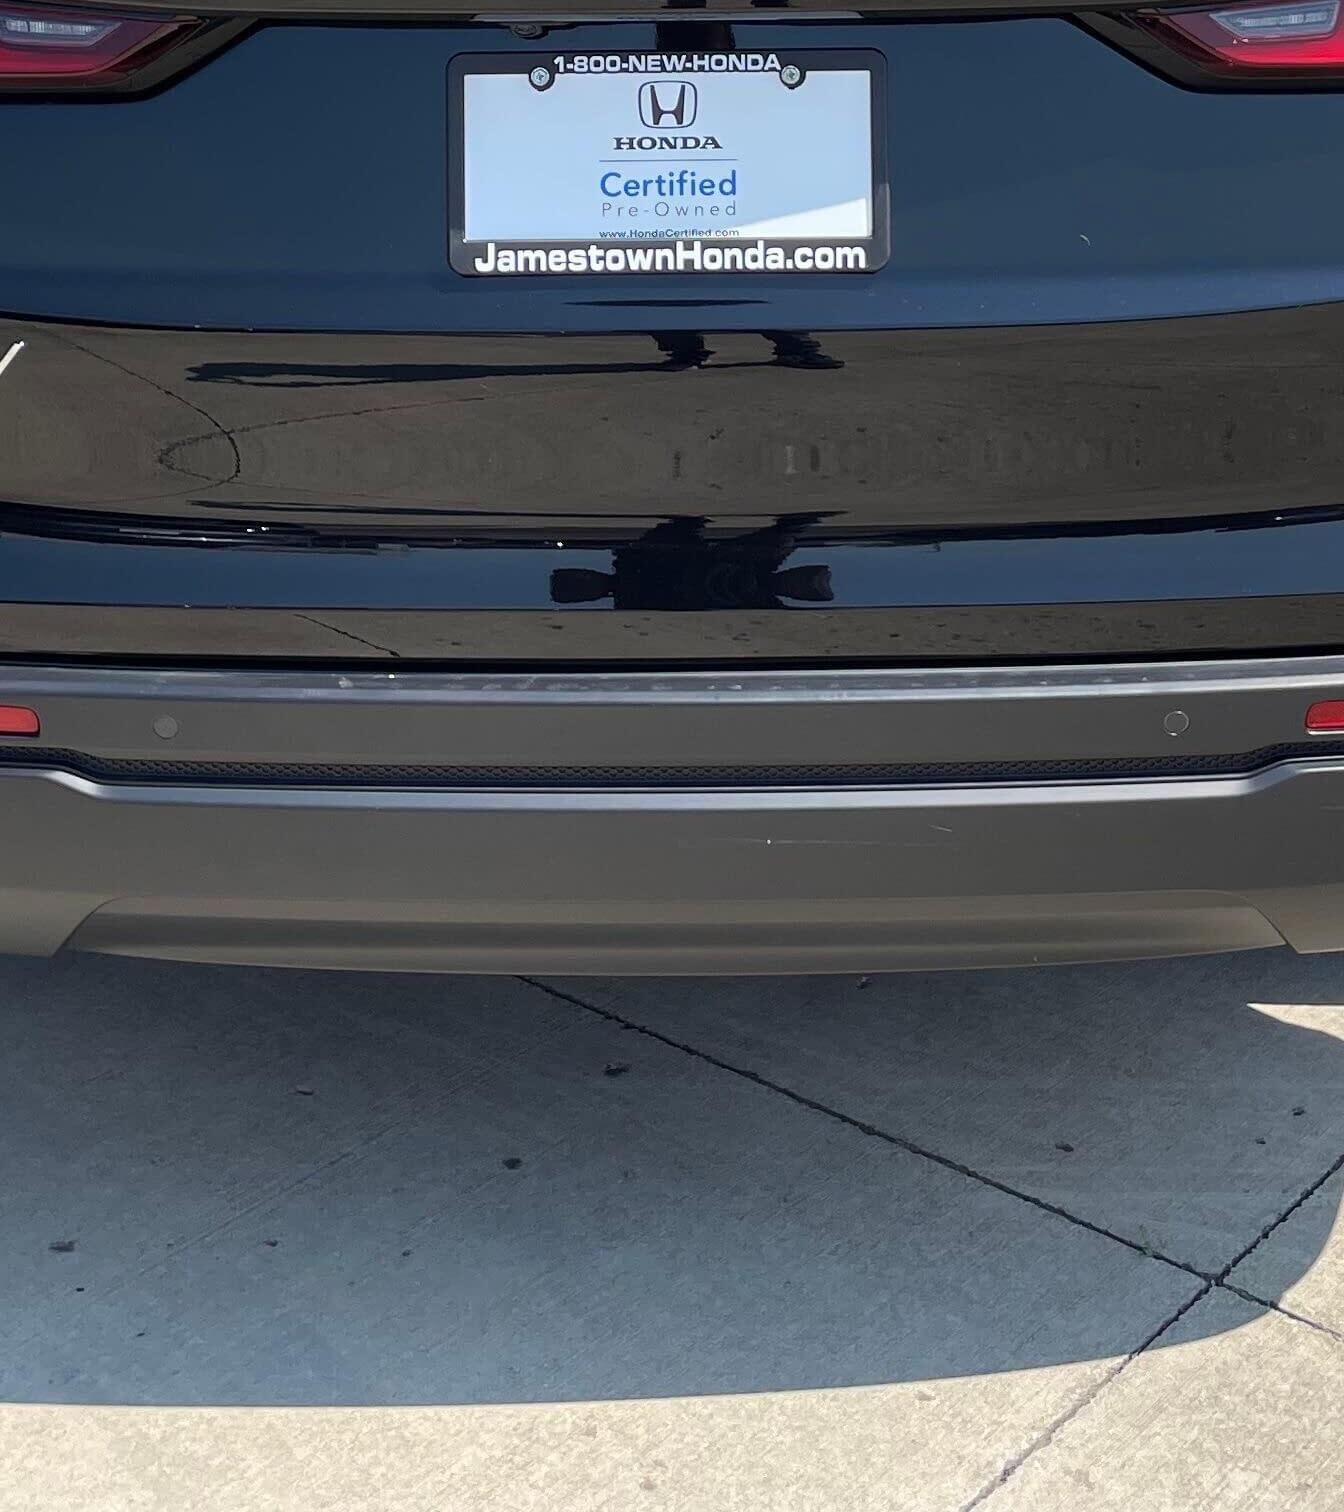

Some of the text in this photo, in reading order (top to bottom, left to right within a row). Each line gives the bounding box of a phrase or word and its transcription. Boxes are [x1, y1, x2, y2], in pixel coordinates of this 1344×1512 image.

[553, 54, 782, 73] 1-800-NEW-HONDA
[613, 136, 723, 150] HONDA
[600, 170, 737, 197] Certified
[601, 202, 737, 217] Pre-Owned
[599, 228, 740, 239] www.HondaCertified.com
[474, 241, 867, 273] JamestownHonda.com
